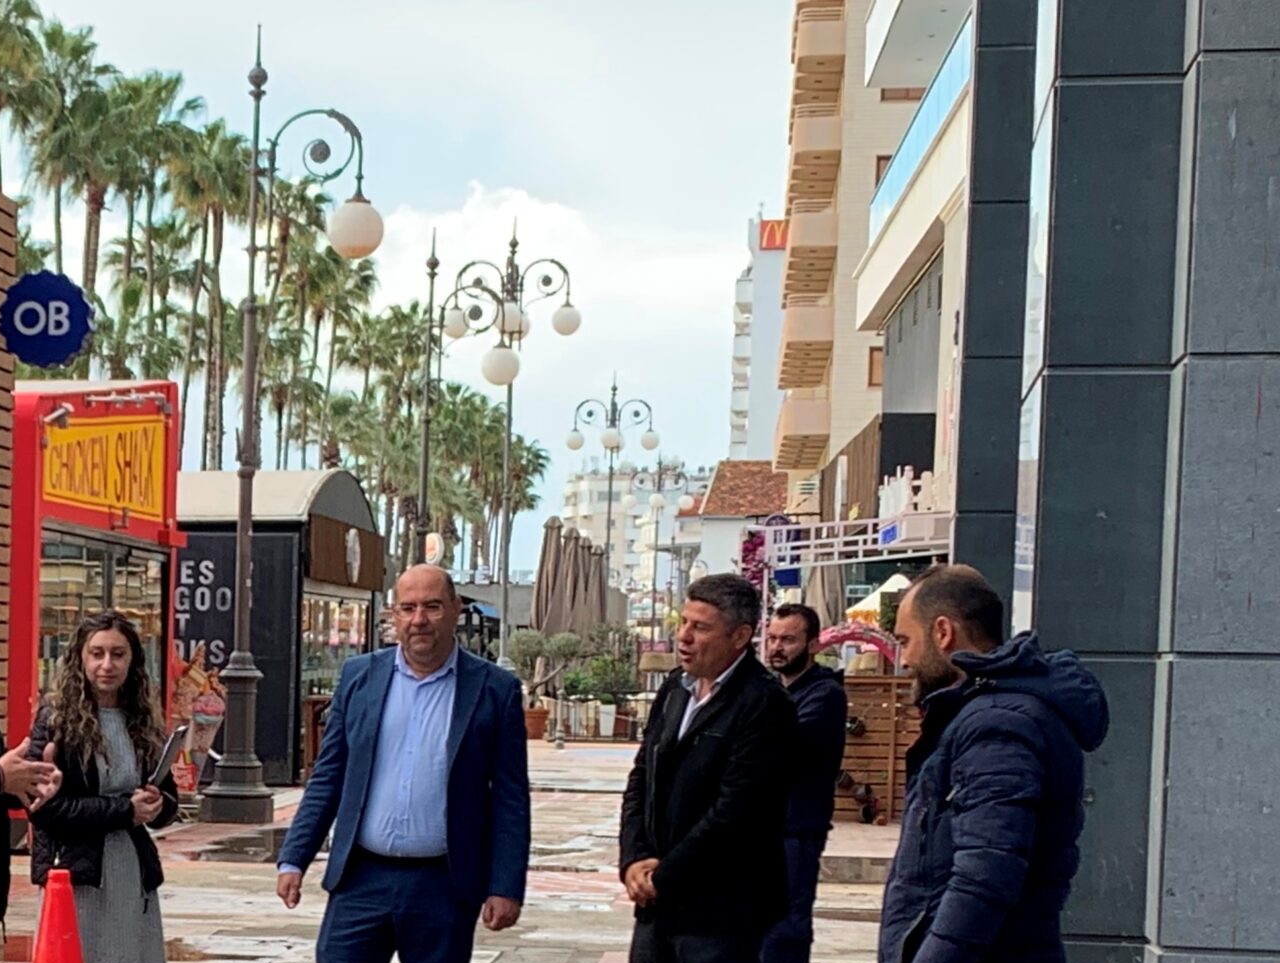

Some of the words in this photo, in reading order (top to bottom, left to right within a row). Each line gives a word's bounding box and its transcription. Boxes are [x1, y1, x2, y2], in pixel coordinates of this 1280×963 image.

[13, 301, 70, 336] OB
[49, 433, 109, 499] CHICKEN
[114, 426, 156, 508] SHACK
[174, 586, 252, 611] GOO
